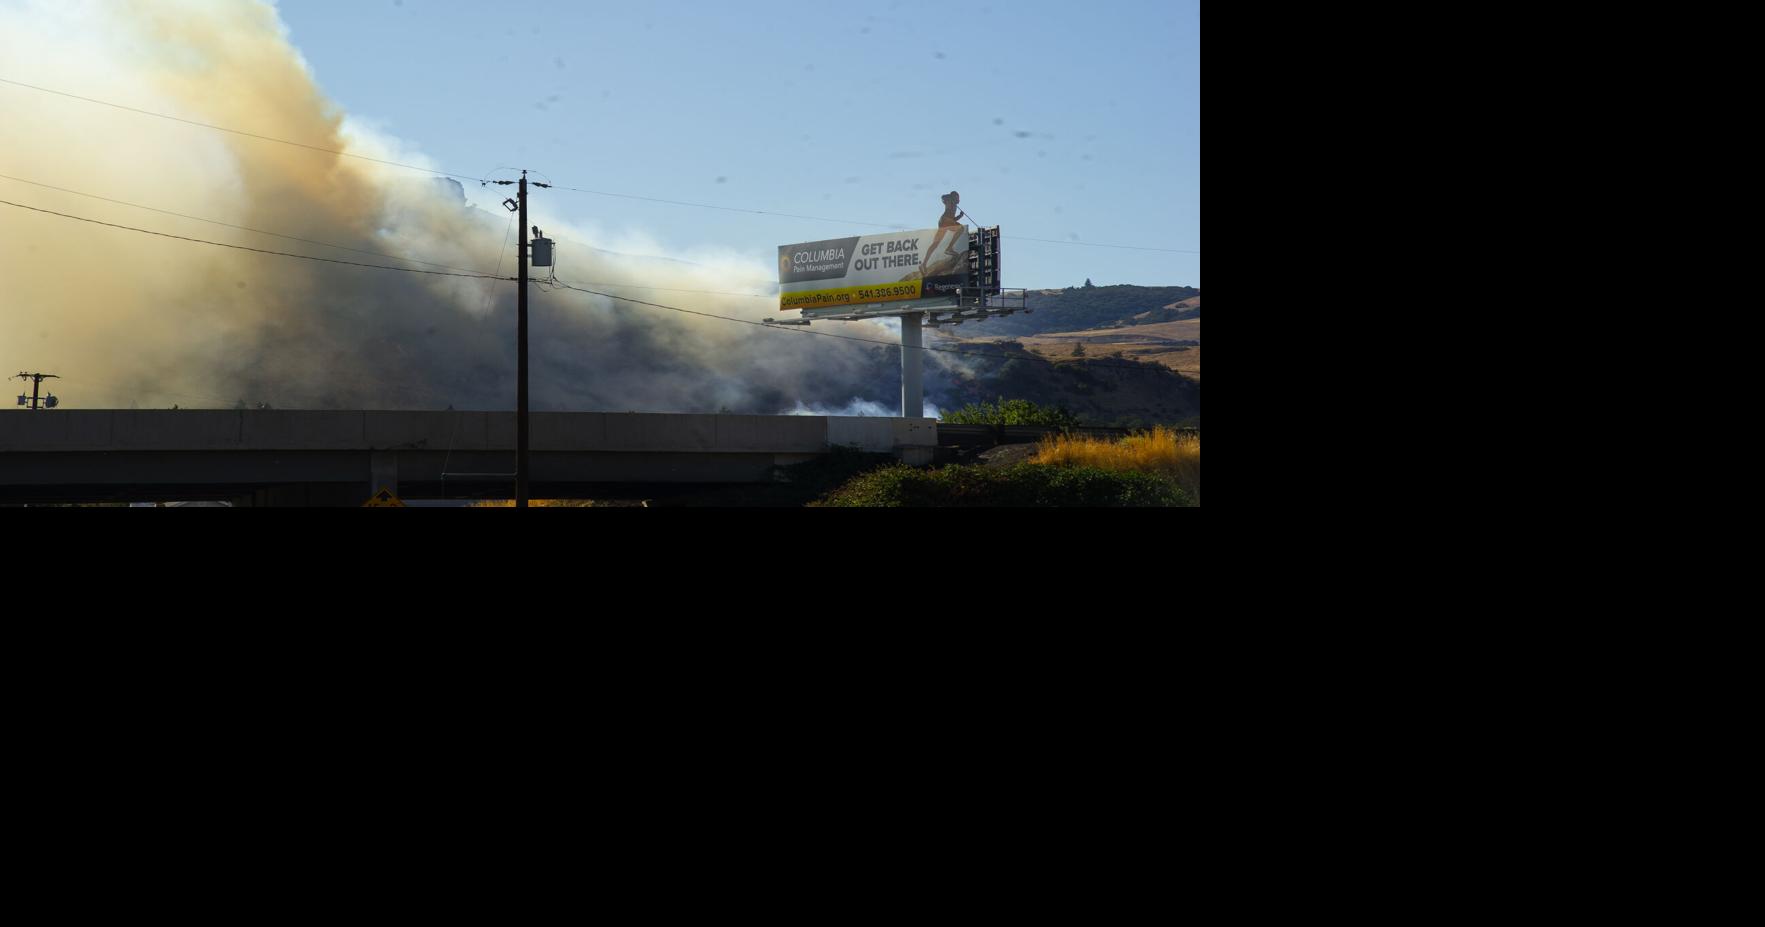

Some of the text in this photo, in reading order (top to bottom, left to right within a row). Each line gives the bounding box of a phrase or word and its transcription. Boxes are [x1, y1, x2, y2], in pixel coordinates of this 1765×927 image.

[793, 247, 845, 264] COLUMBIA
[861, 238, 919, 256] GET BACK
[793, 262, 844, 273] Pain Management
[854, 253, 922, 271] OUT THERE.
